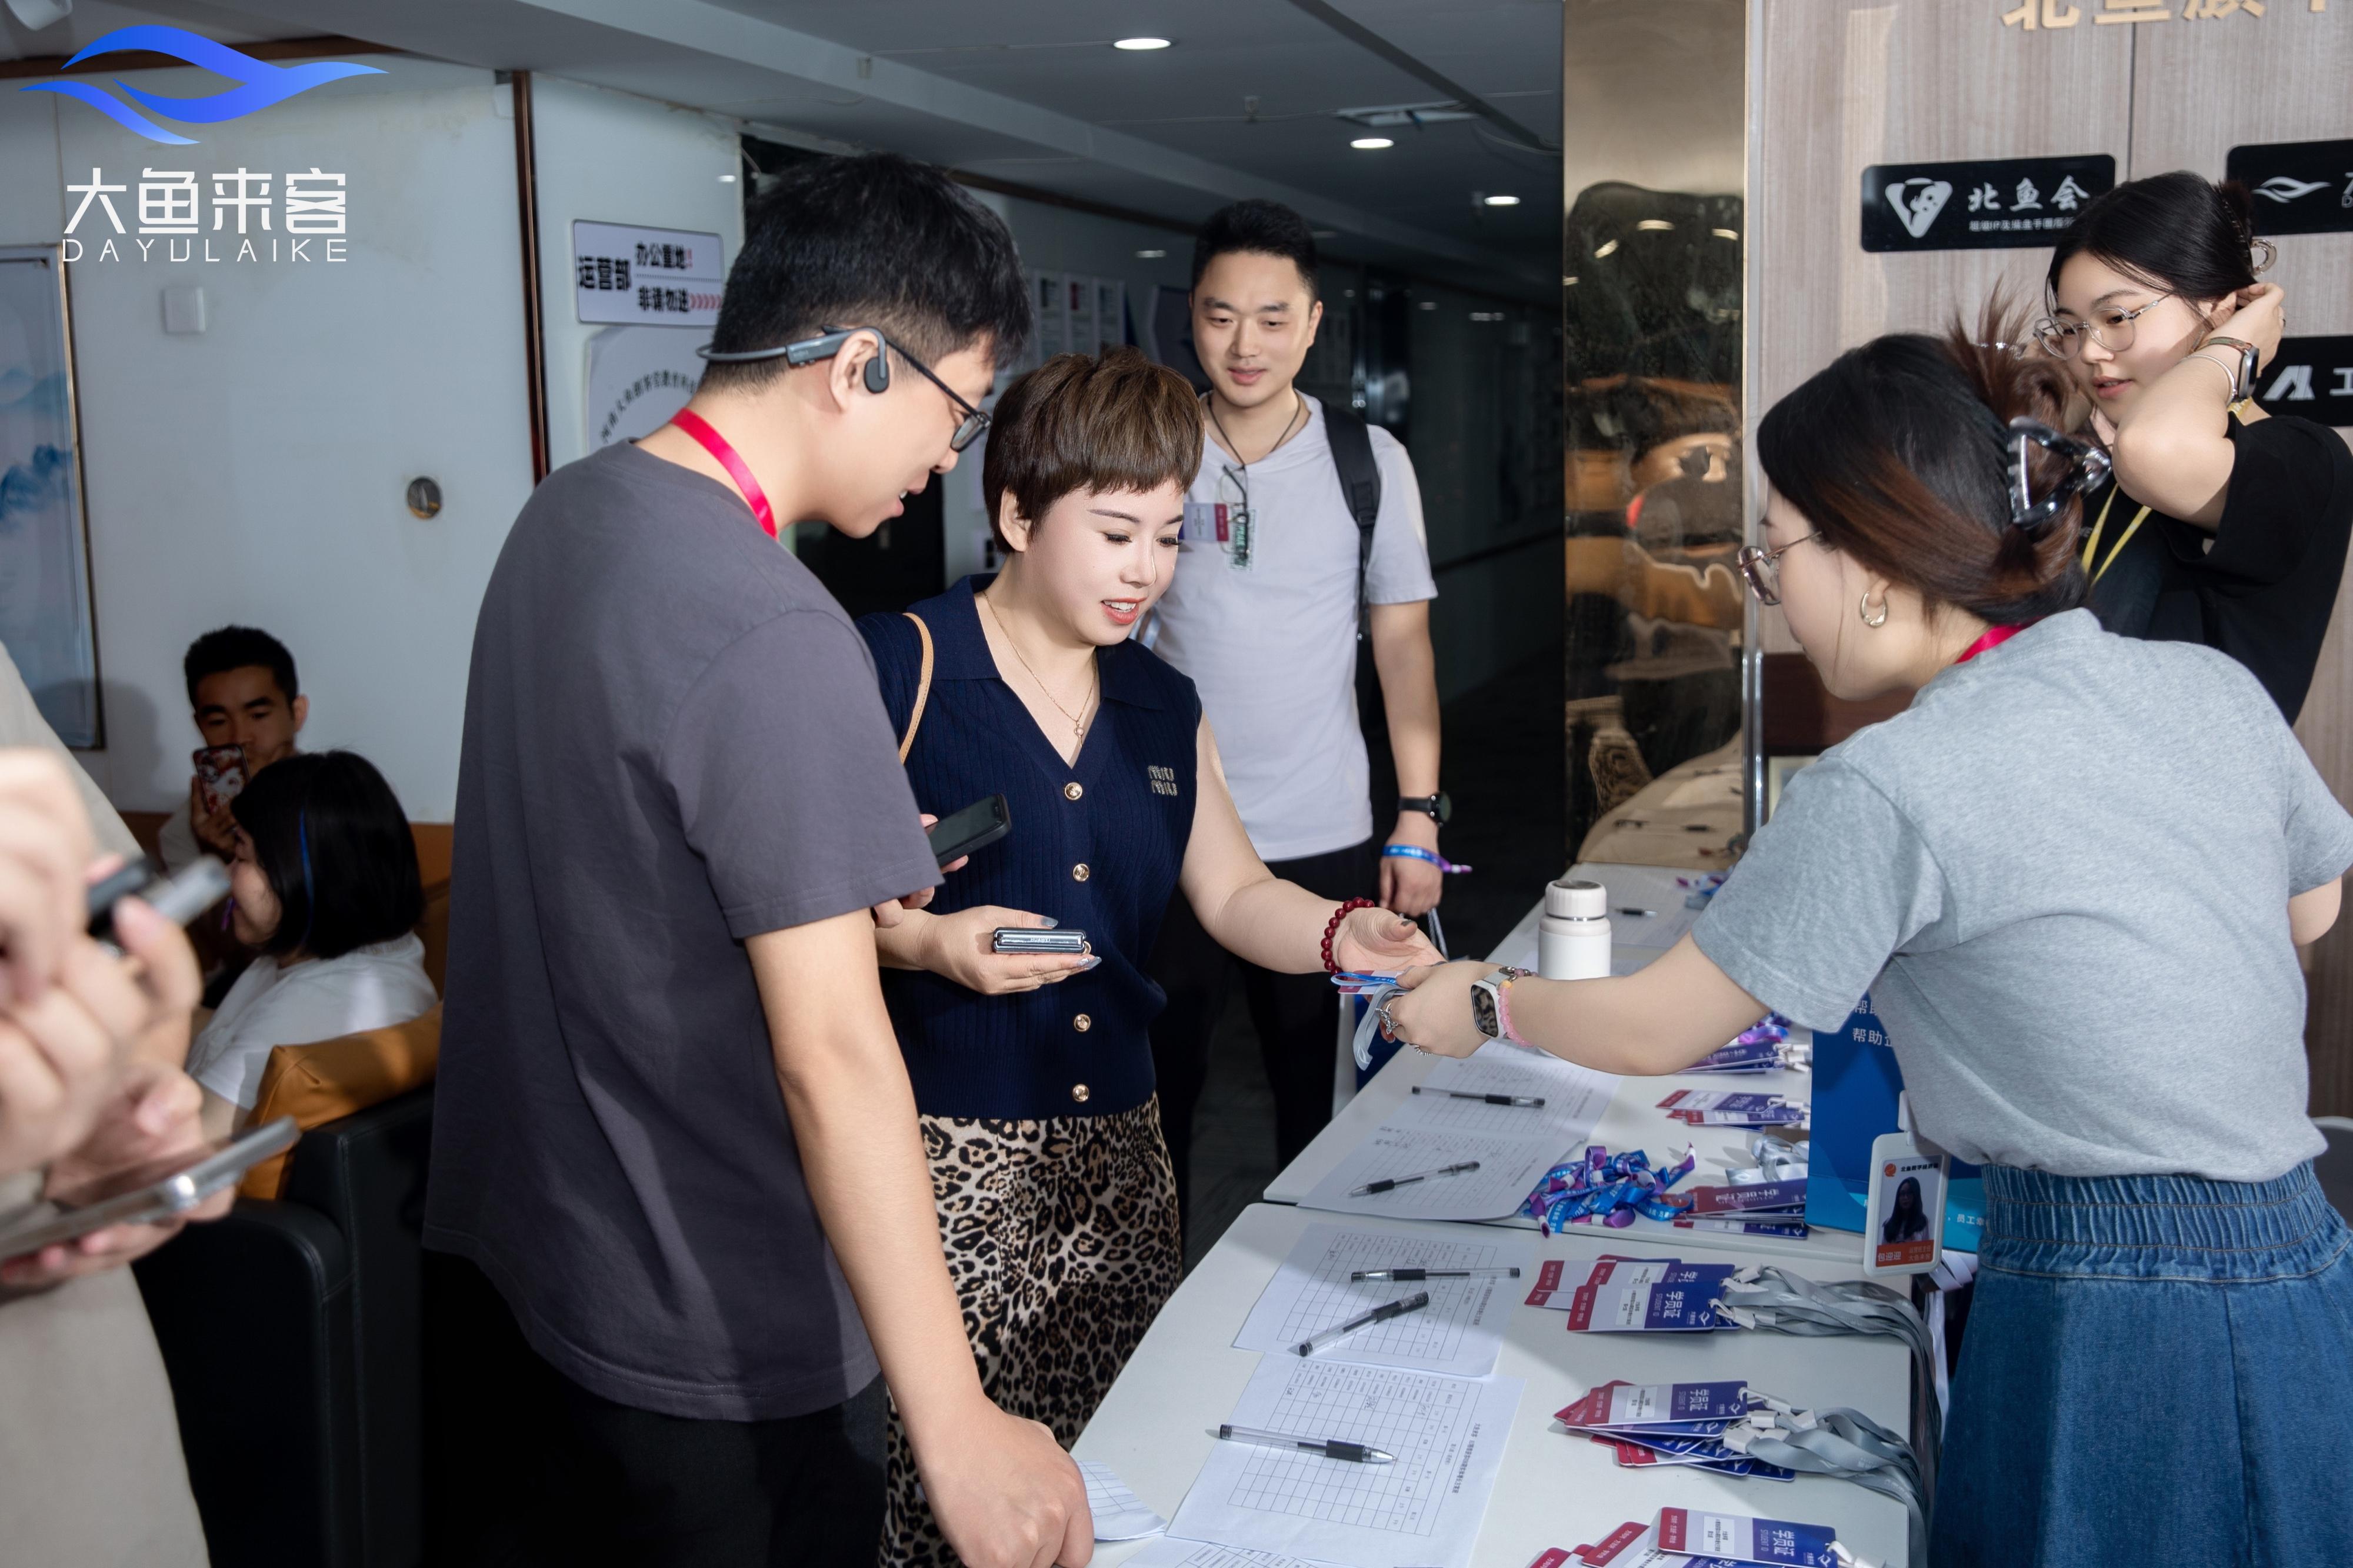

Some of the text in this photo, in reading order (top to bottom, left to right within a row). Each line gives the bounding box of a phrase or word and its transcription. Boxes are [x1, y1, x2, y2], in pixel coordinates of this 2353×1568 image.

[1968, 175, 2091, 212] 北鱼会
[1663, 1290, 1685, 1319] 学员证
[1689, 1389, 1710, 1412] 学员证
[1772, 1529, 1795, 1557] 学员证
